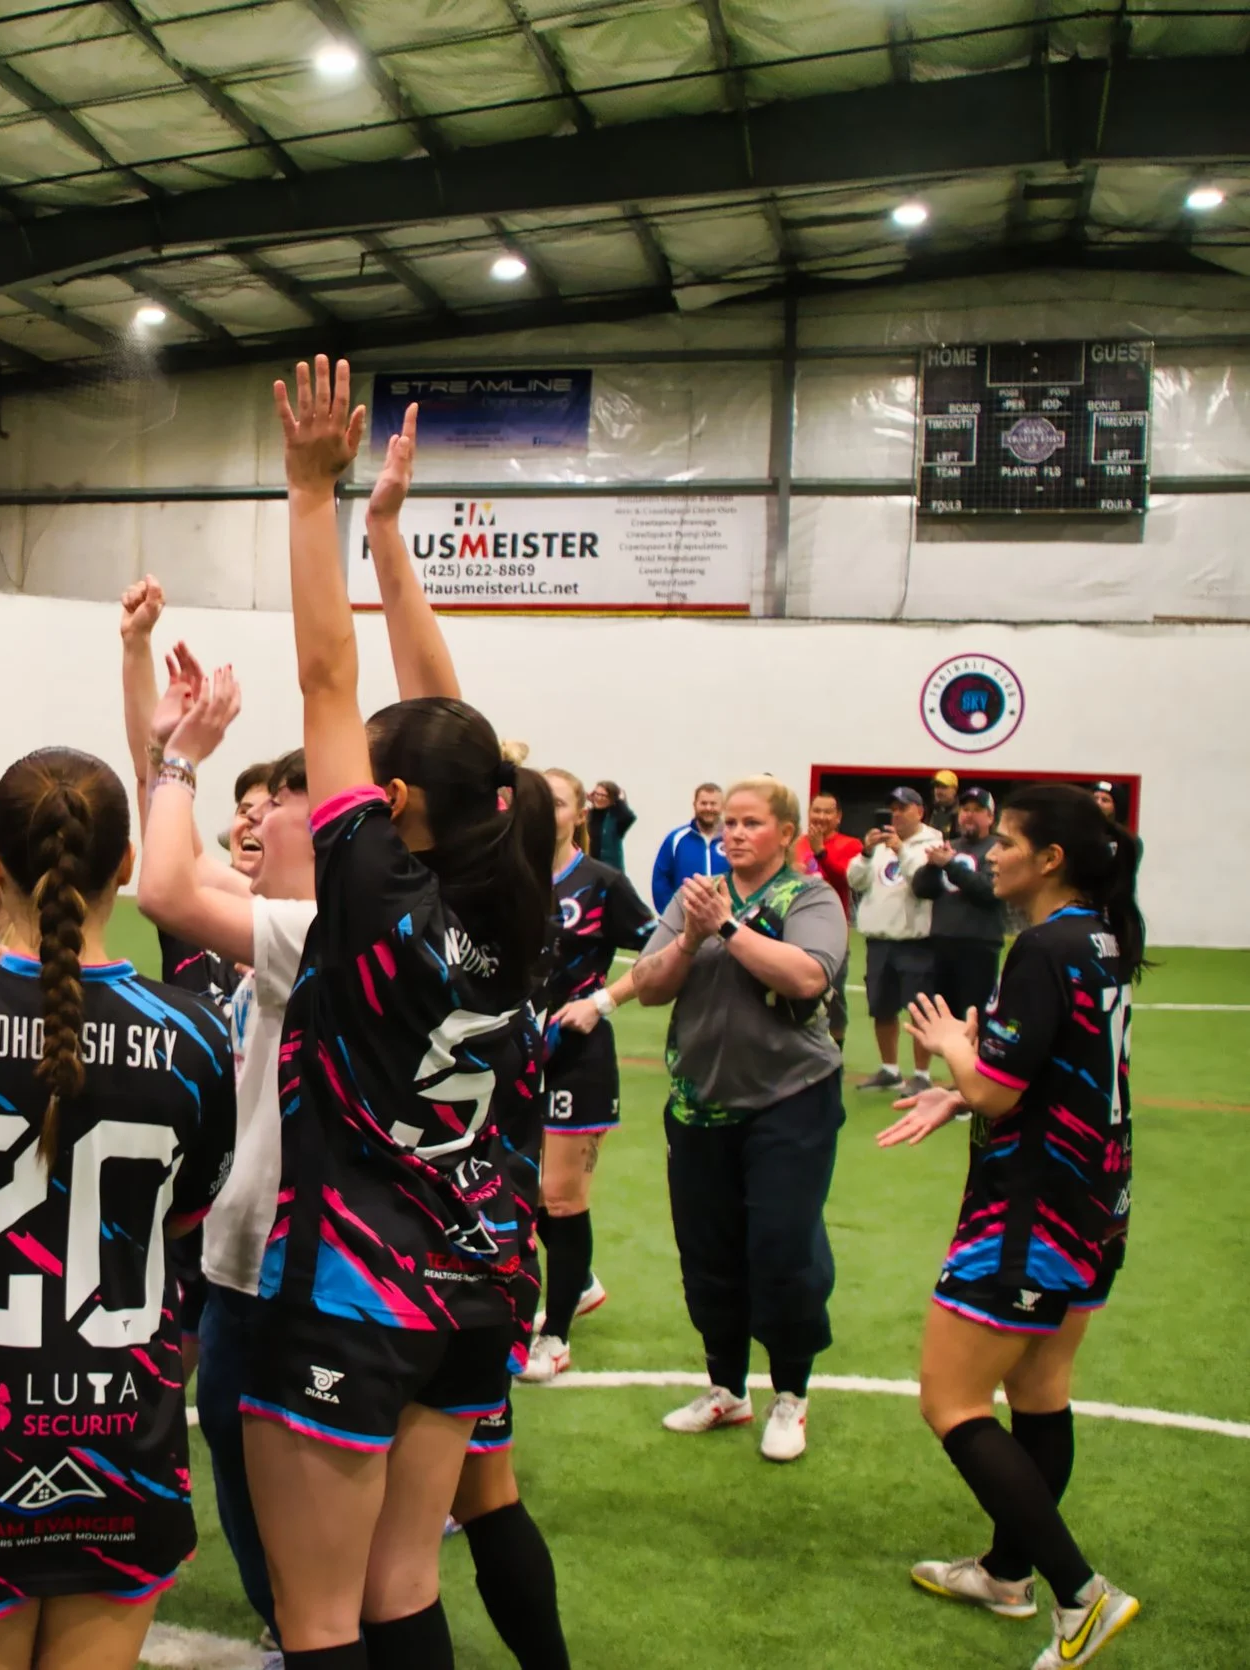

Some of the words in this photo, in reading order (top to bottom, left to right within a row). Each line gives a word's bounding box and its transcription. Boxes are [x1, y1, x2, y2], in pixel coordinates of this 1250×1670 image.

[927, 348, 977, 367] HOME
[1091, 342, 1150, 363] GUEST
[390, 378, 573, 395] STREAMLINE
[948, 402, 981, 414] BONUS
[1088, 400, 1121, 411] BONUS
[927, 418, 972, 430] TIMEOUTS
[1098, 416, 1144, 428] TIMEOUTS
[937, 451, 960, 462] LEFT
[1107, 450, 1130, 461] LEFT
[936, 467, 961, 477] TEAM
[1001, 466, 1038, 477] PLAYER
[1044, 466, 1062, 477] FLS
[1105, 466, 1131, 476] TEAM
[930, 500, 962, 511] FOULS
[1101, 499, 1132, 510] FOULS
[362, 532, 599, 559] USMEISTER
[423, 564, 461, 578] (425)
[466, 564, 535, 577] 622-8869
[423, 582, 579, 595] HausmeisterLLC.net
[127, 1027, 177, 1071] SKY
[549, 1090, 573, 1119] 13
[424, 1269, 462, 1281] REALTORS
[26, 1371, 139, 1405] LUTA
[305, 1387, 340, 1404] DIAZA
[23, 1411, 139, 1436] SECURITY
[34, 1516, 136, 1533] EVANGER
[16, 1538, 41, 1547] WHO
[43, 1532, 72, 1543] MOVE
[75, 1531, 136, 1541] MOUNTAINS
